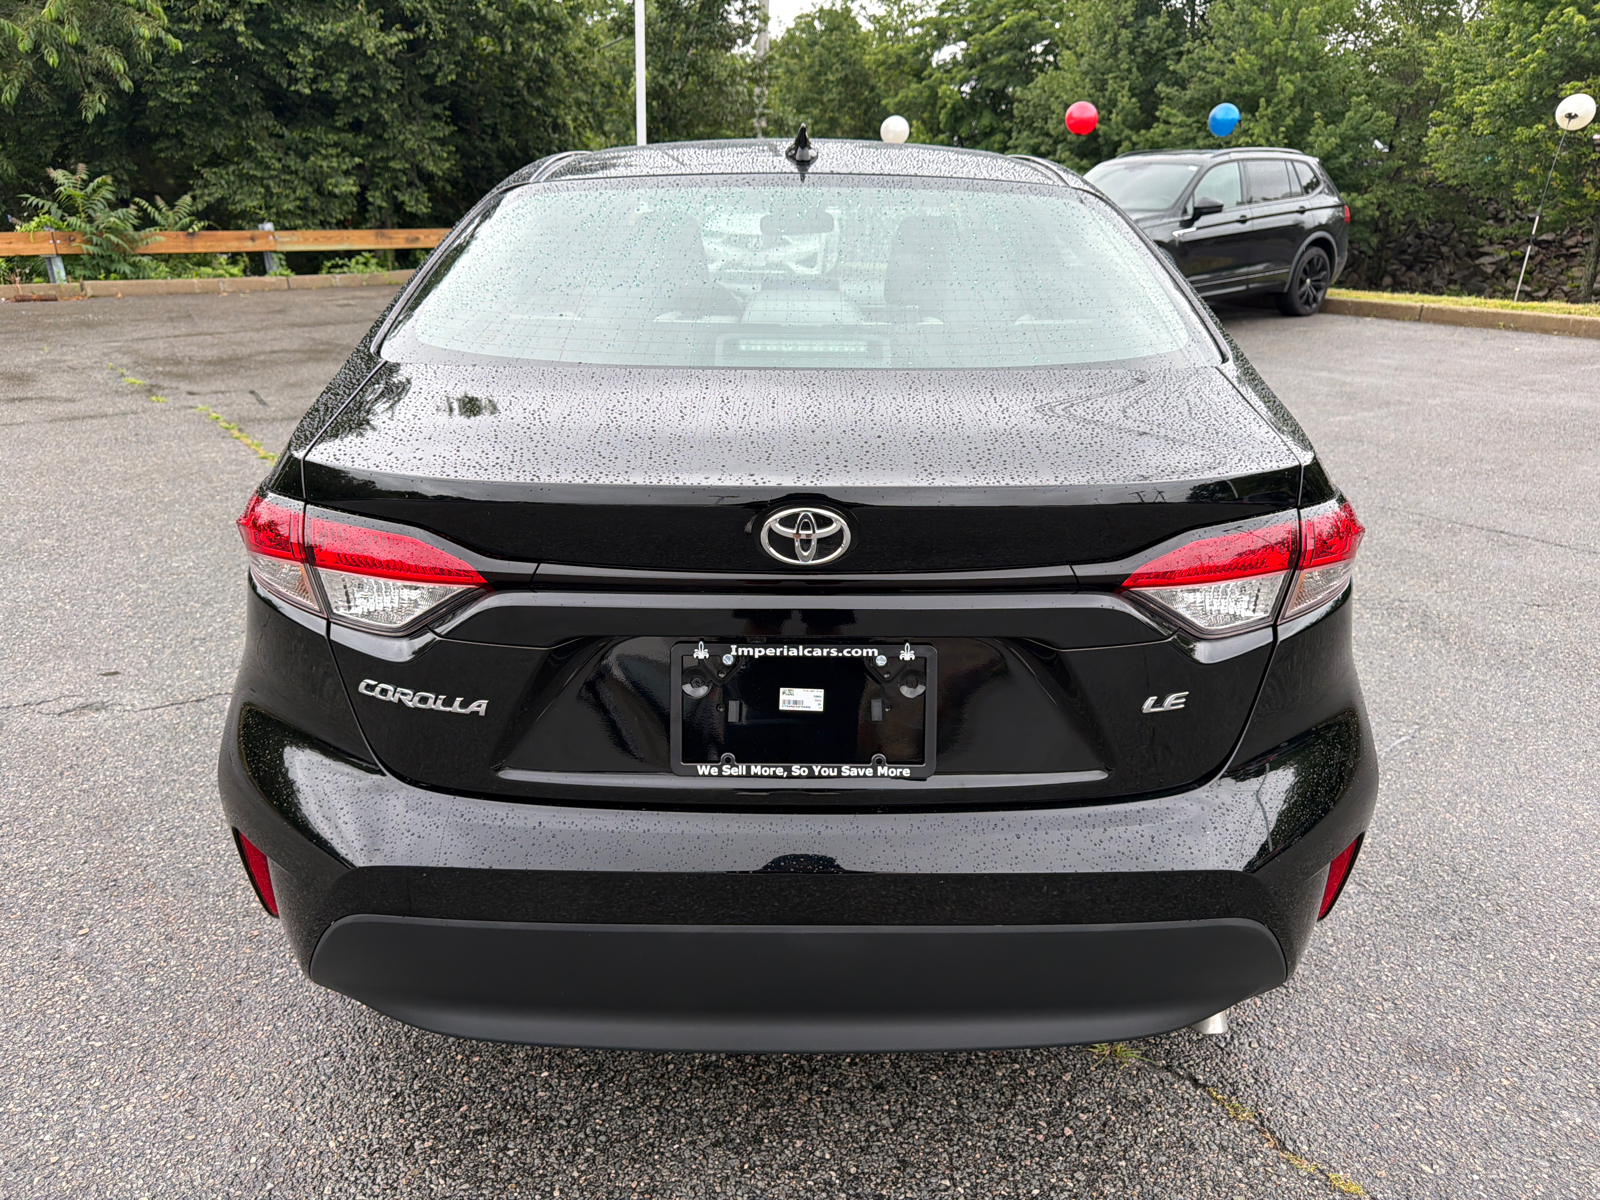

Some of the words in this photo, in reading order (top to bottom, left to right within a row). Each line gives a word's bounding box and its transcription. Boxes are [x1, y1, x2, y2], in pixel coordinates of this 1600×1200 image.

[730, 645, 879, 658] Imperialcars.com
[358, 679, 489, 716] COROLLA
[1141, 691, 1190, 714] LE
[697, 765, 719, 776] We
[722, 765, 746, 776] Sell
[751, 765, 787, 778] More,
[791, 765, 808, 777] So
[812, 766, 838, 777] You
[841, 766, 874, 777] Save
[877, 766, 911, 777] More
